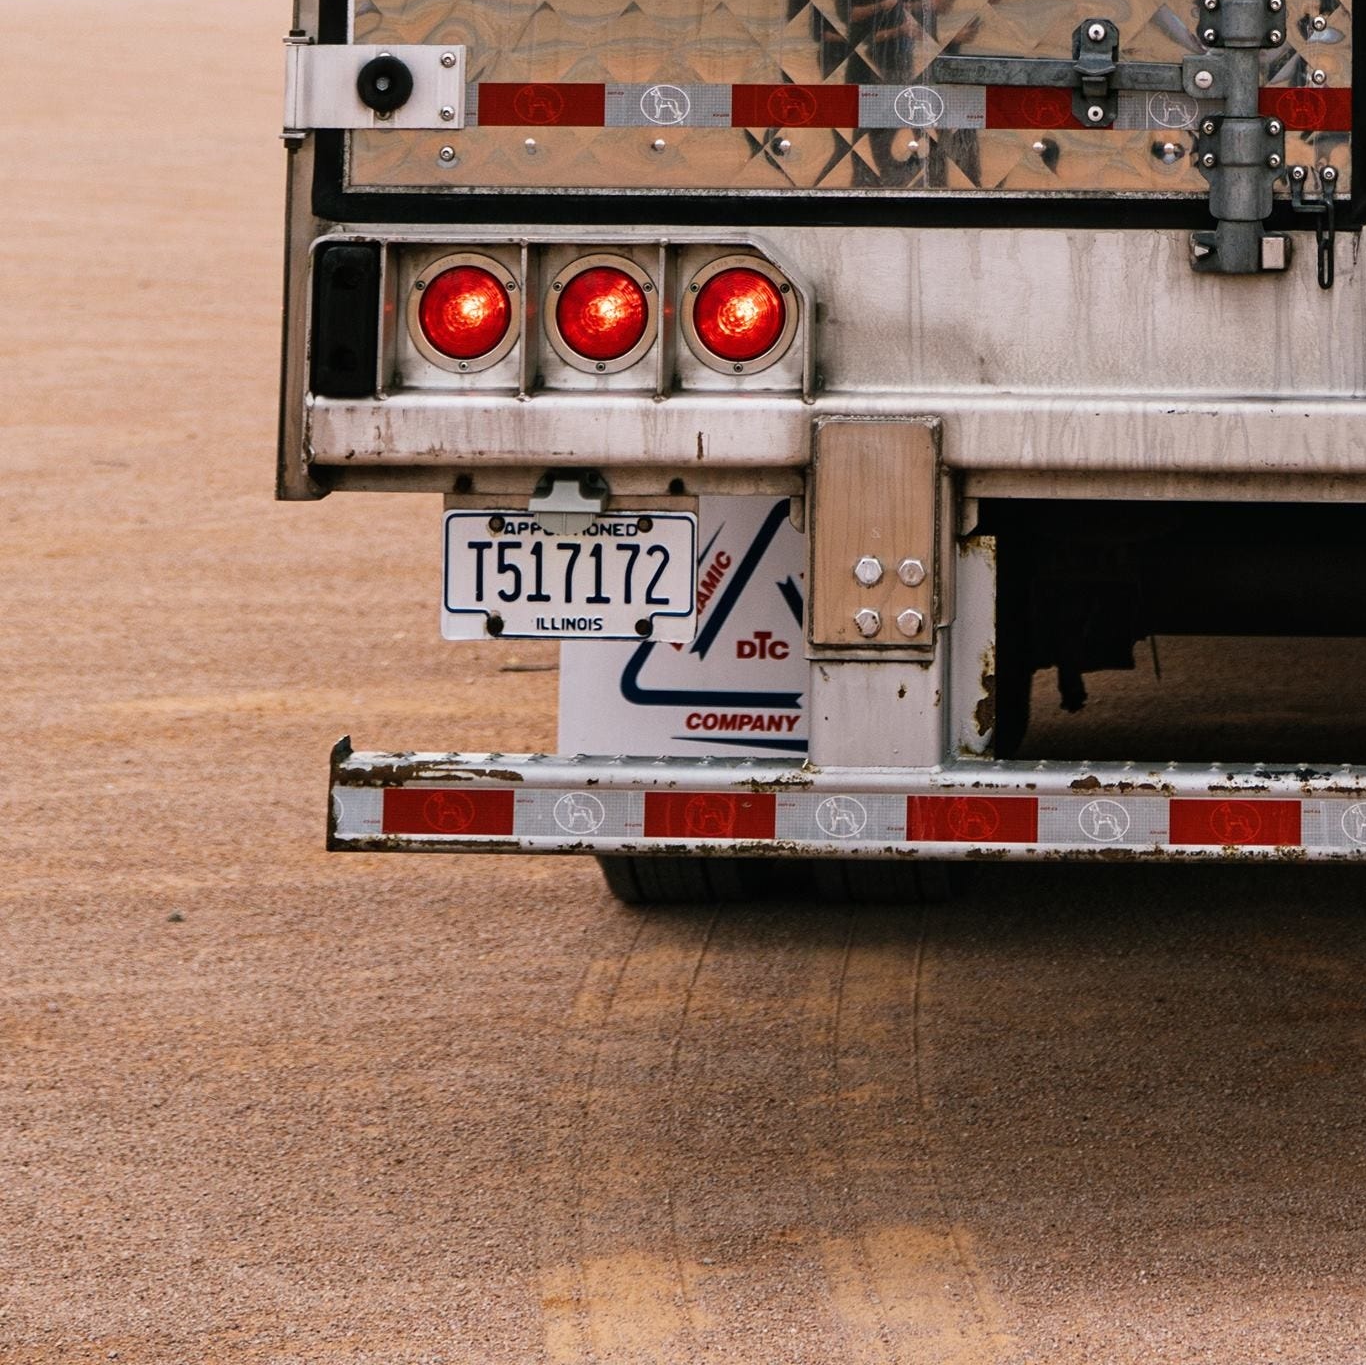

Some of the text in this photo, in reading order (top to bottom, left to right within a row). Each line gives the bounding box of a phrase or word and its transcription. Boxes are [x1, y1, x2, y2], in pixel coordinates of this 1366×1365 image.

[468, 541, 670, 605] T517172
[536, 617, 603, 631] ILLINOIS
[736, 631, 790, 660] DTC
[685, 712, 800, 732] COMPANY
